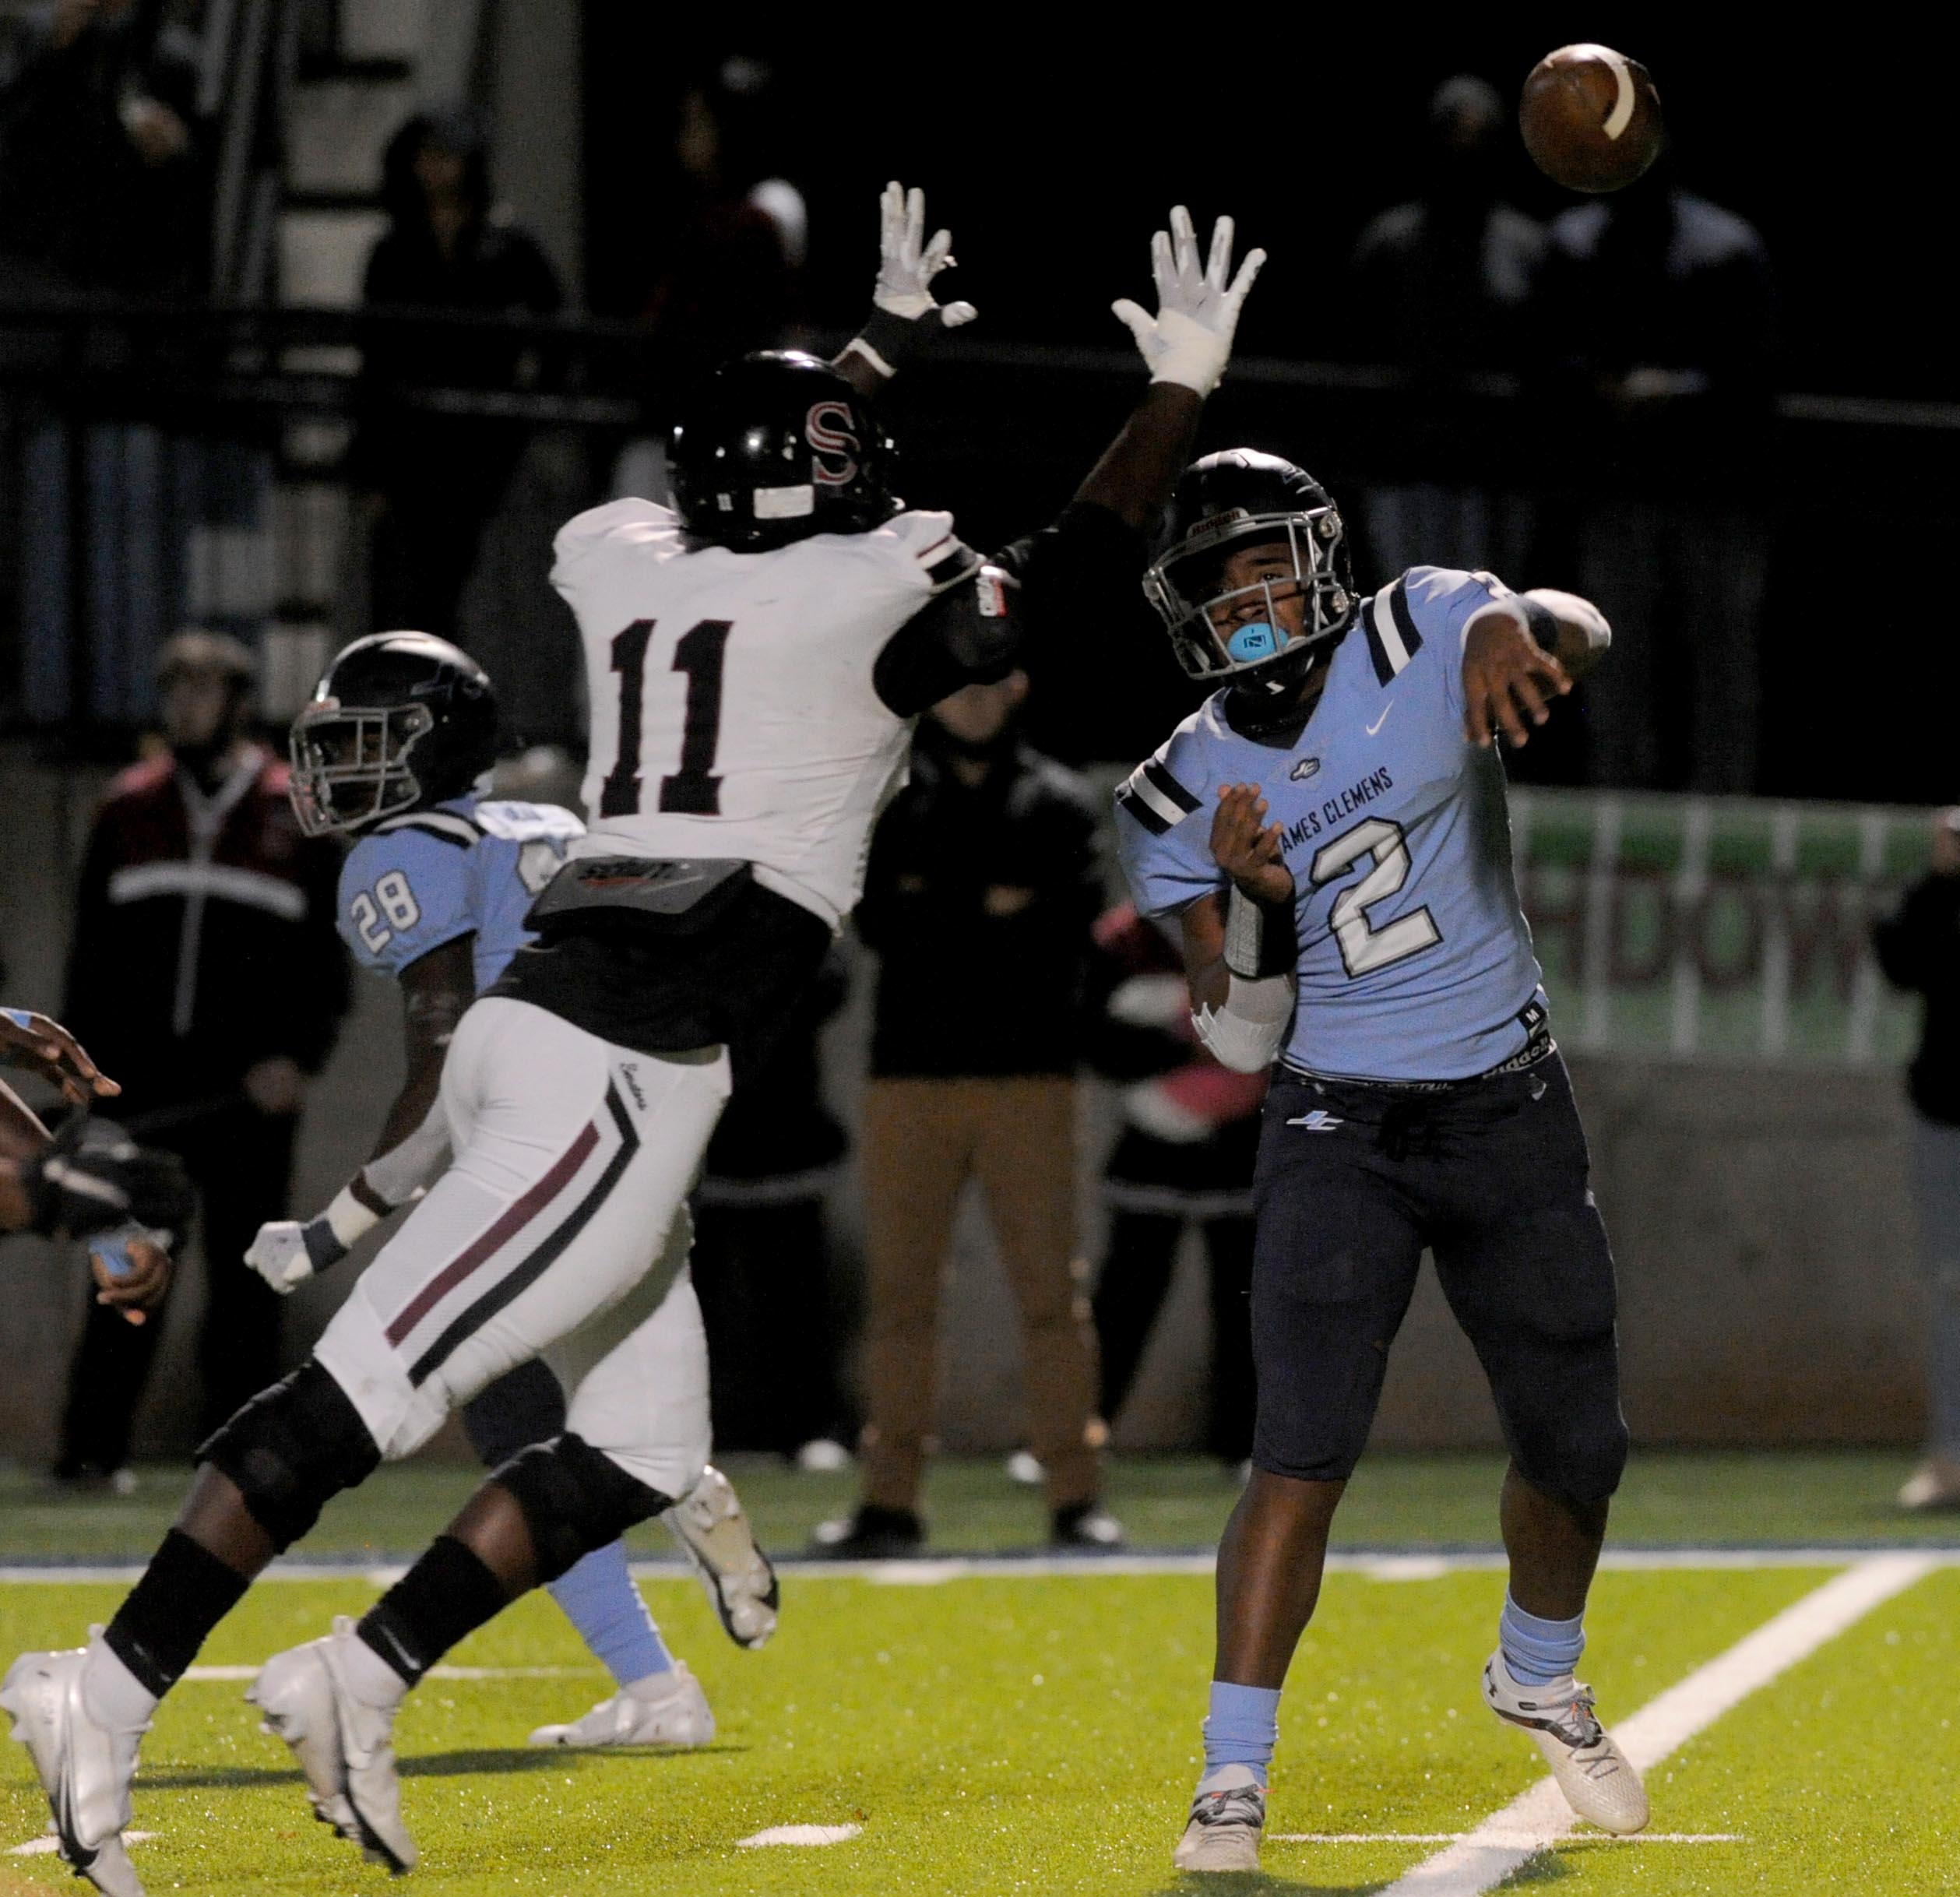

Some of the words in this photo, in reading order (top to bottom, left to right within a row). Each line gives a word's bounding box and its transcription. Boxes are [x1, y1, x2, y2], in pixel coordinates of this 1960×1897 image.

[806, 400, 860, 486] S
[600, 619, 735, 818] 11
[1279, 811, 1322, 854] AMES
[1322, 766, 1393, 825] CLEMENS
[350, 870, 421, 956] 28
[1311, 815, 1443, 980] 2
[1525, 1008, 1540, 1023] M
